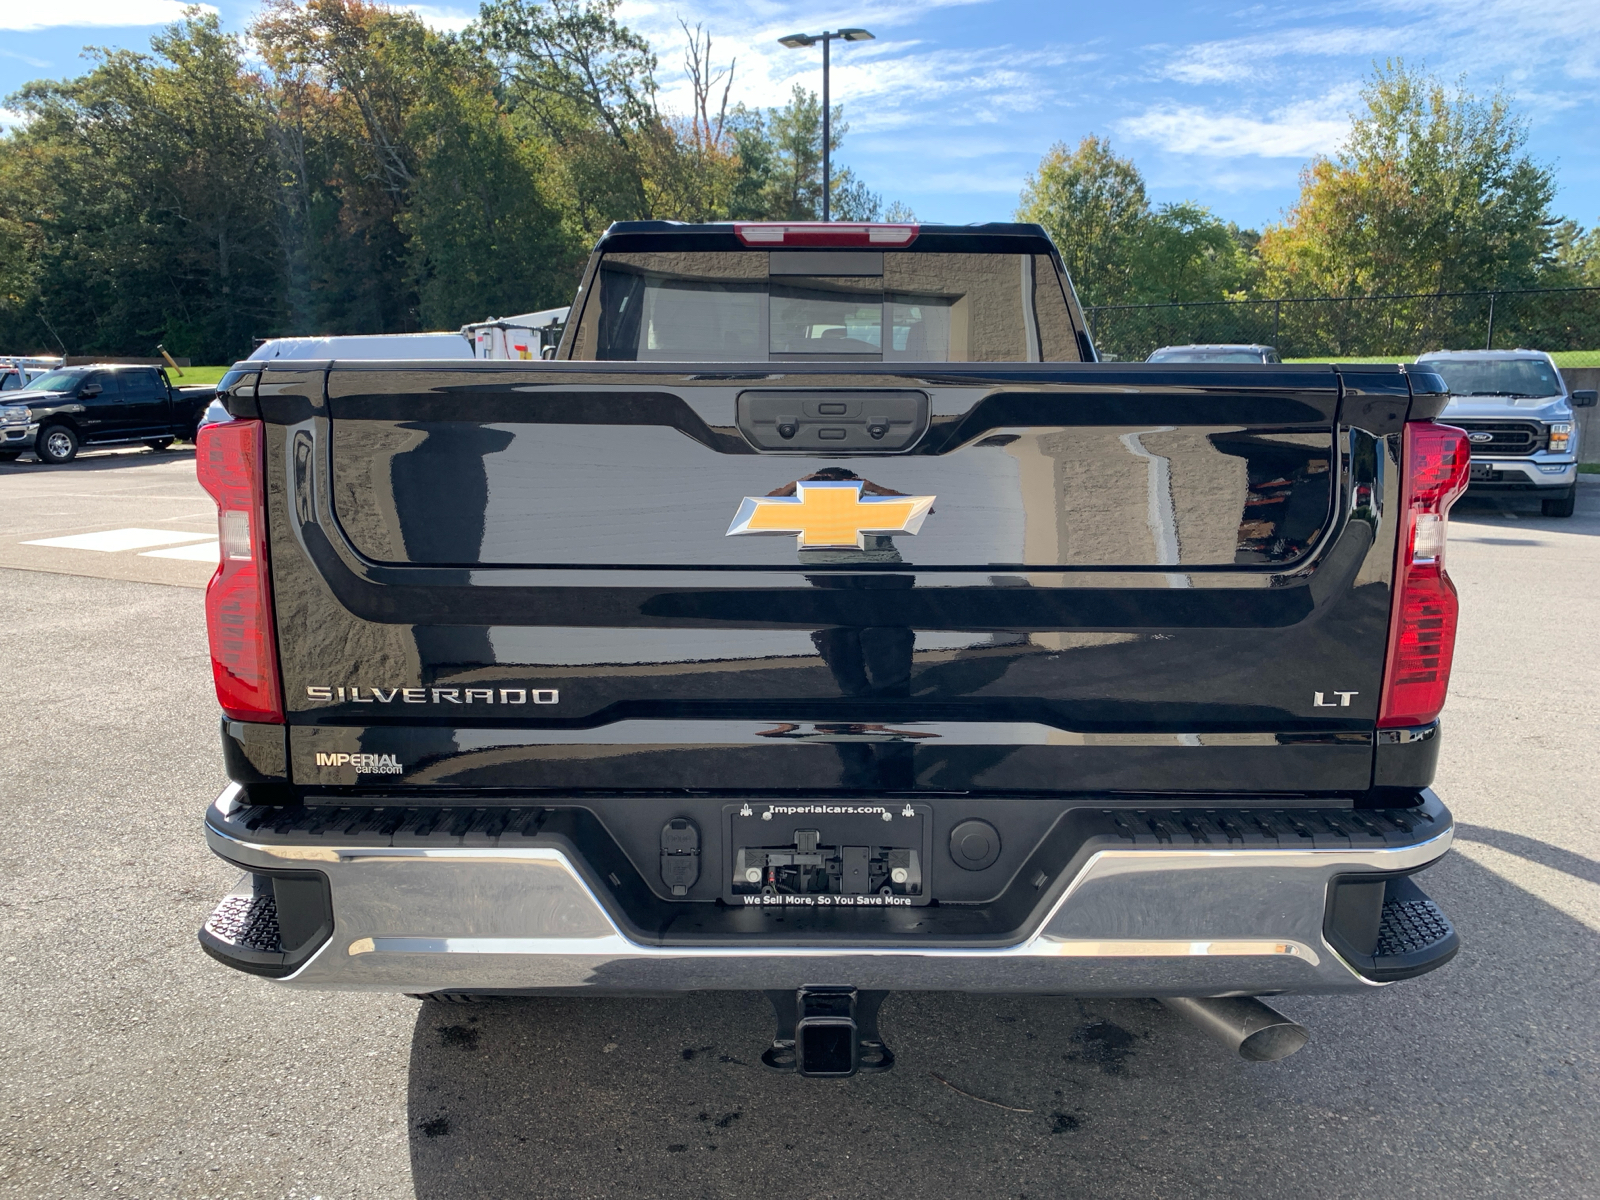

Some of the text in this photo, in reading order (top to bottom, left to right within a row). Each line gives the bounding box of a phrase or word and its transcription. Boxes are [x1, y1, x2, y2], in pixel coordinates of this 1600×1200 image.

[306, 685, 560, 705] SILVERADO
[1313, 691, 1359, 707] LT
[316, 752, 403, 767] IMPERIAL
[355, 766, 403, 775] cars.com
[769, 804, 886, 815] Imperialcars.com
[743, 896, 911, 906] We Sell More, So You Save More
